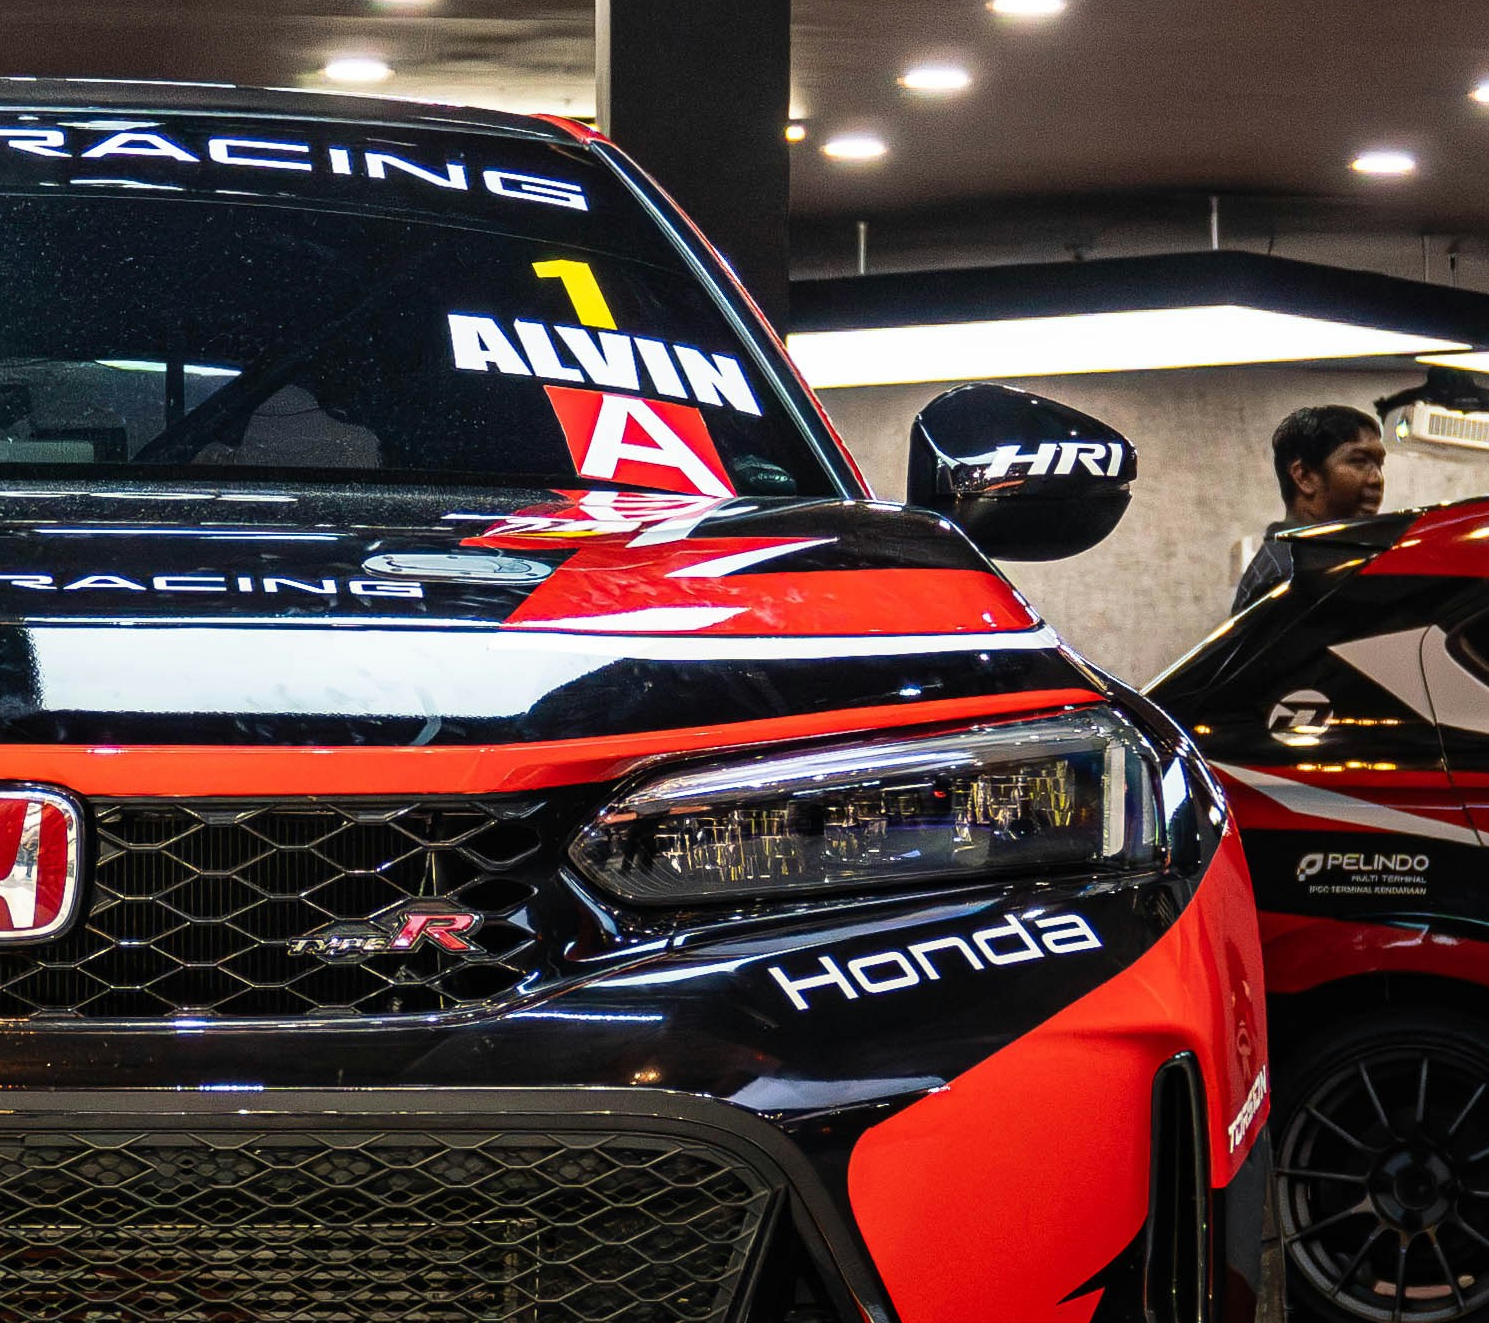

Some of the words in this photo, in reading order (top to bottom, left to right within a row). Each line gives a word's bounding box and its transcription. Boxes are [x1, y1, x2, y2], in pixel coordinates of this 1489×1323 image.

[531, 259, 618, 331] 1
[447, 313, 764, 417] ALVIN
[579, 392, 736, 499] A
[1327, 854, 1429, 872] PELINDO
[1330, 885, 1372, 894] TERMINAL
[1381, 874, 1428, 884] TERMINAL
[288, 936, 390, 957] TYPE
[389, 912, 486, 954] R
[767, 913, 1103, 1012] Honda
